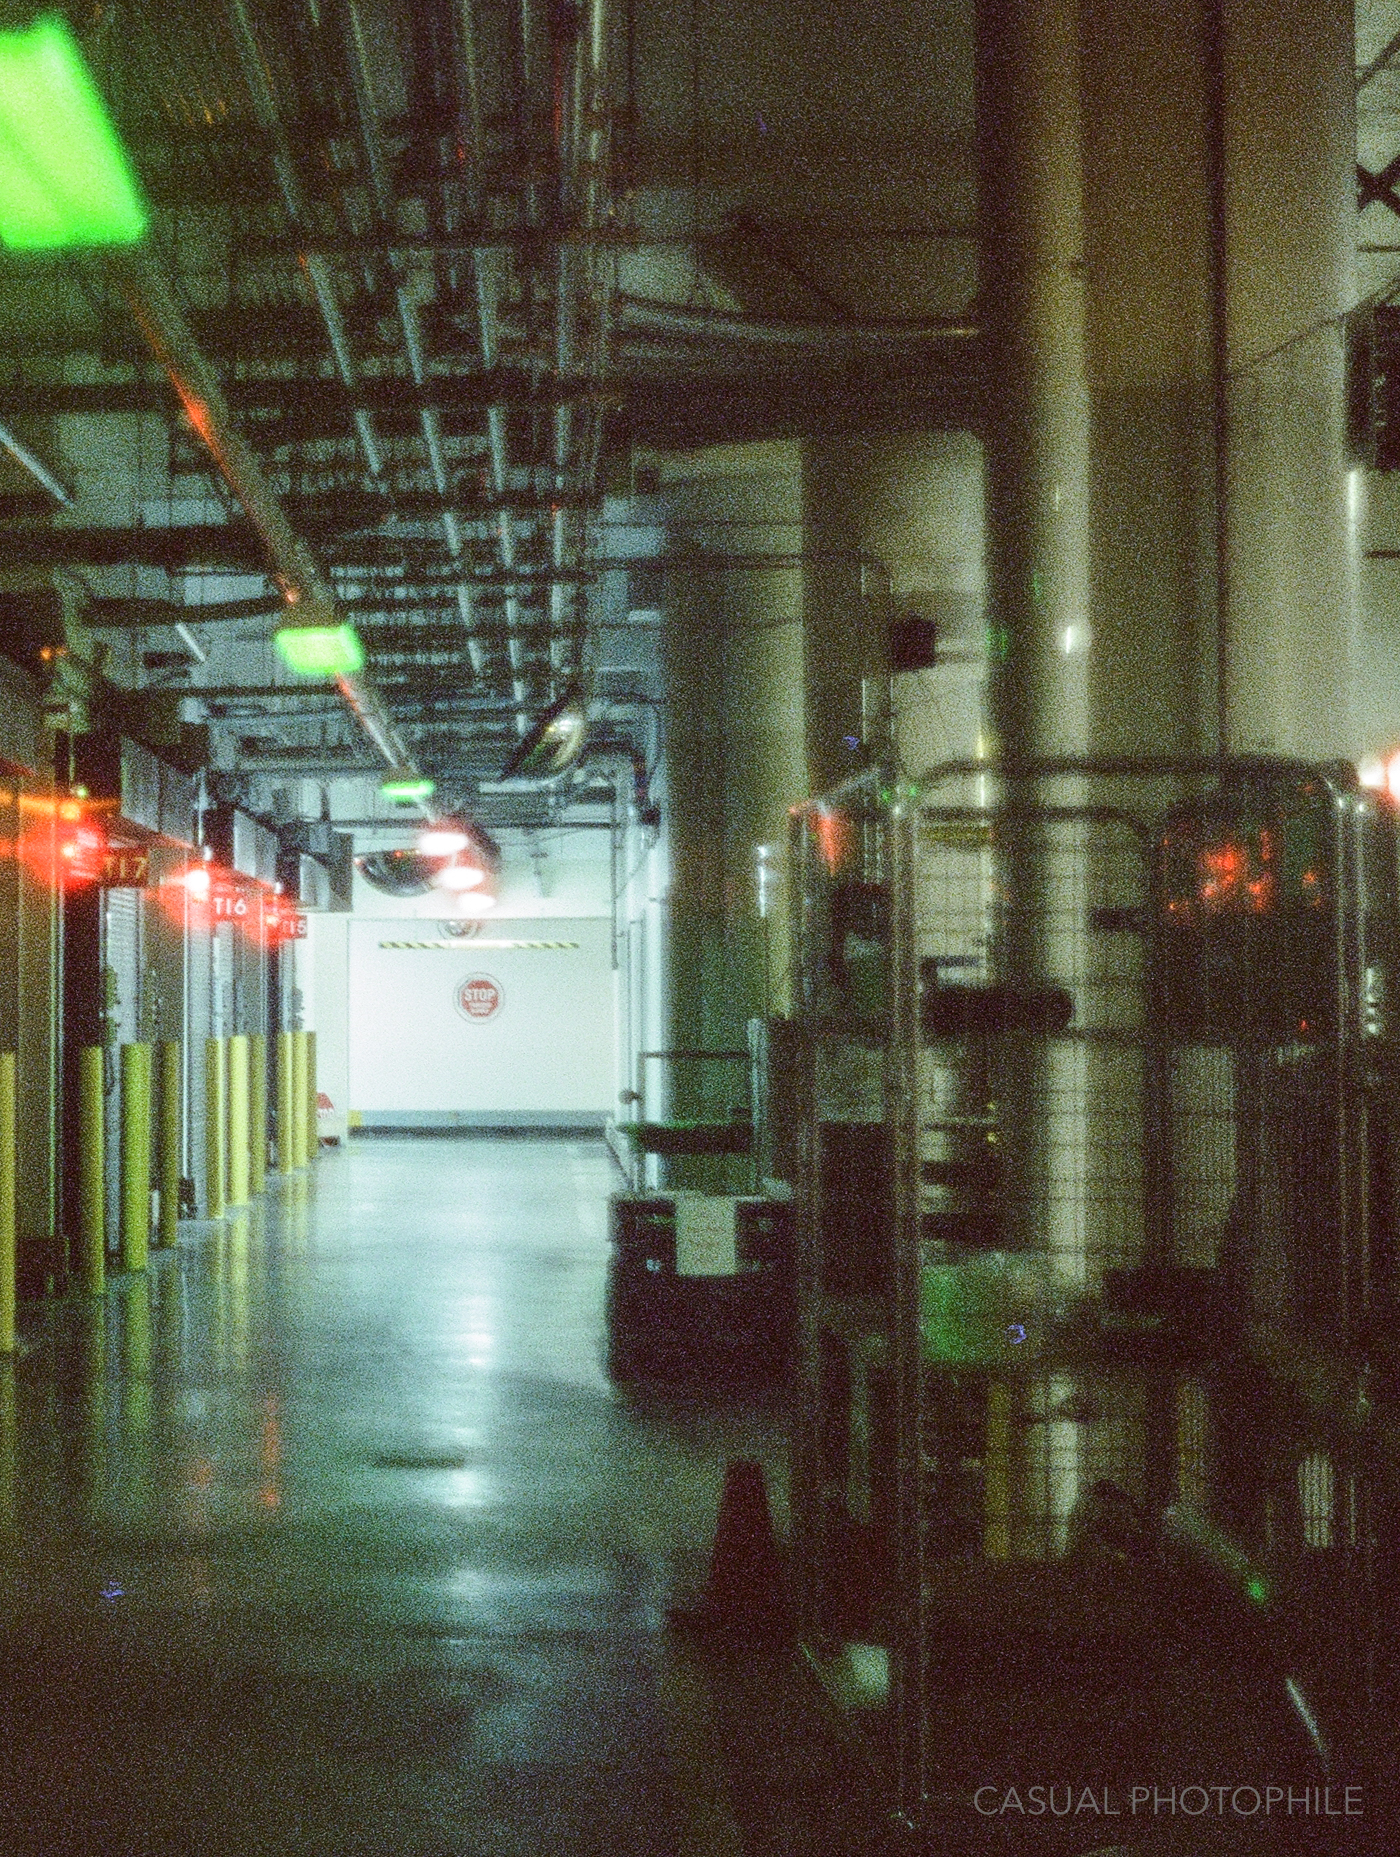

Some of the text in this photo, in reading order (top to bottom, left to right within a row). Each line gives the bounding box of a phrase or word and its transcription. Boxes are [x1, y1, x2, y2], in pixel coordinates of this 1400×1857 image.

[103, 856, 148, 879] T17
[213, 897, 247, 915] T16
[463, 987, 496, 1002] STOP
